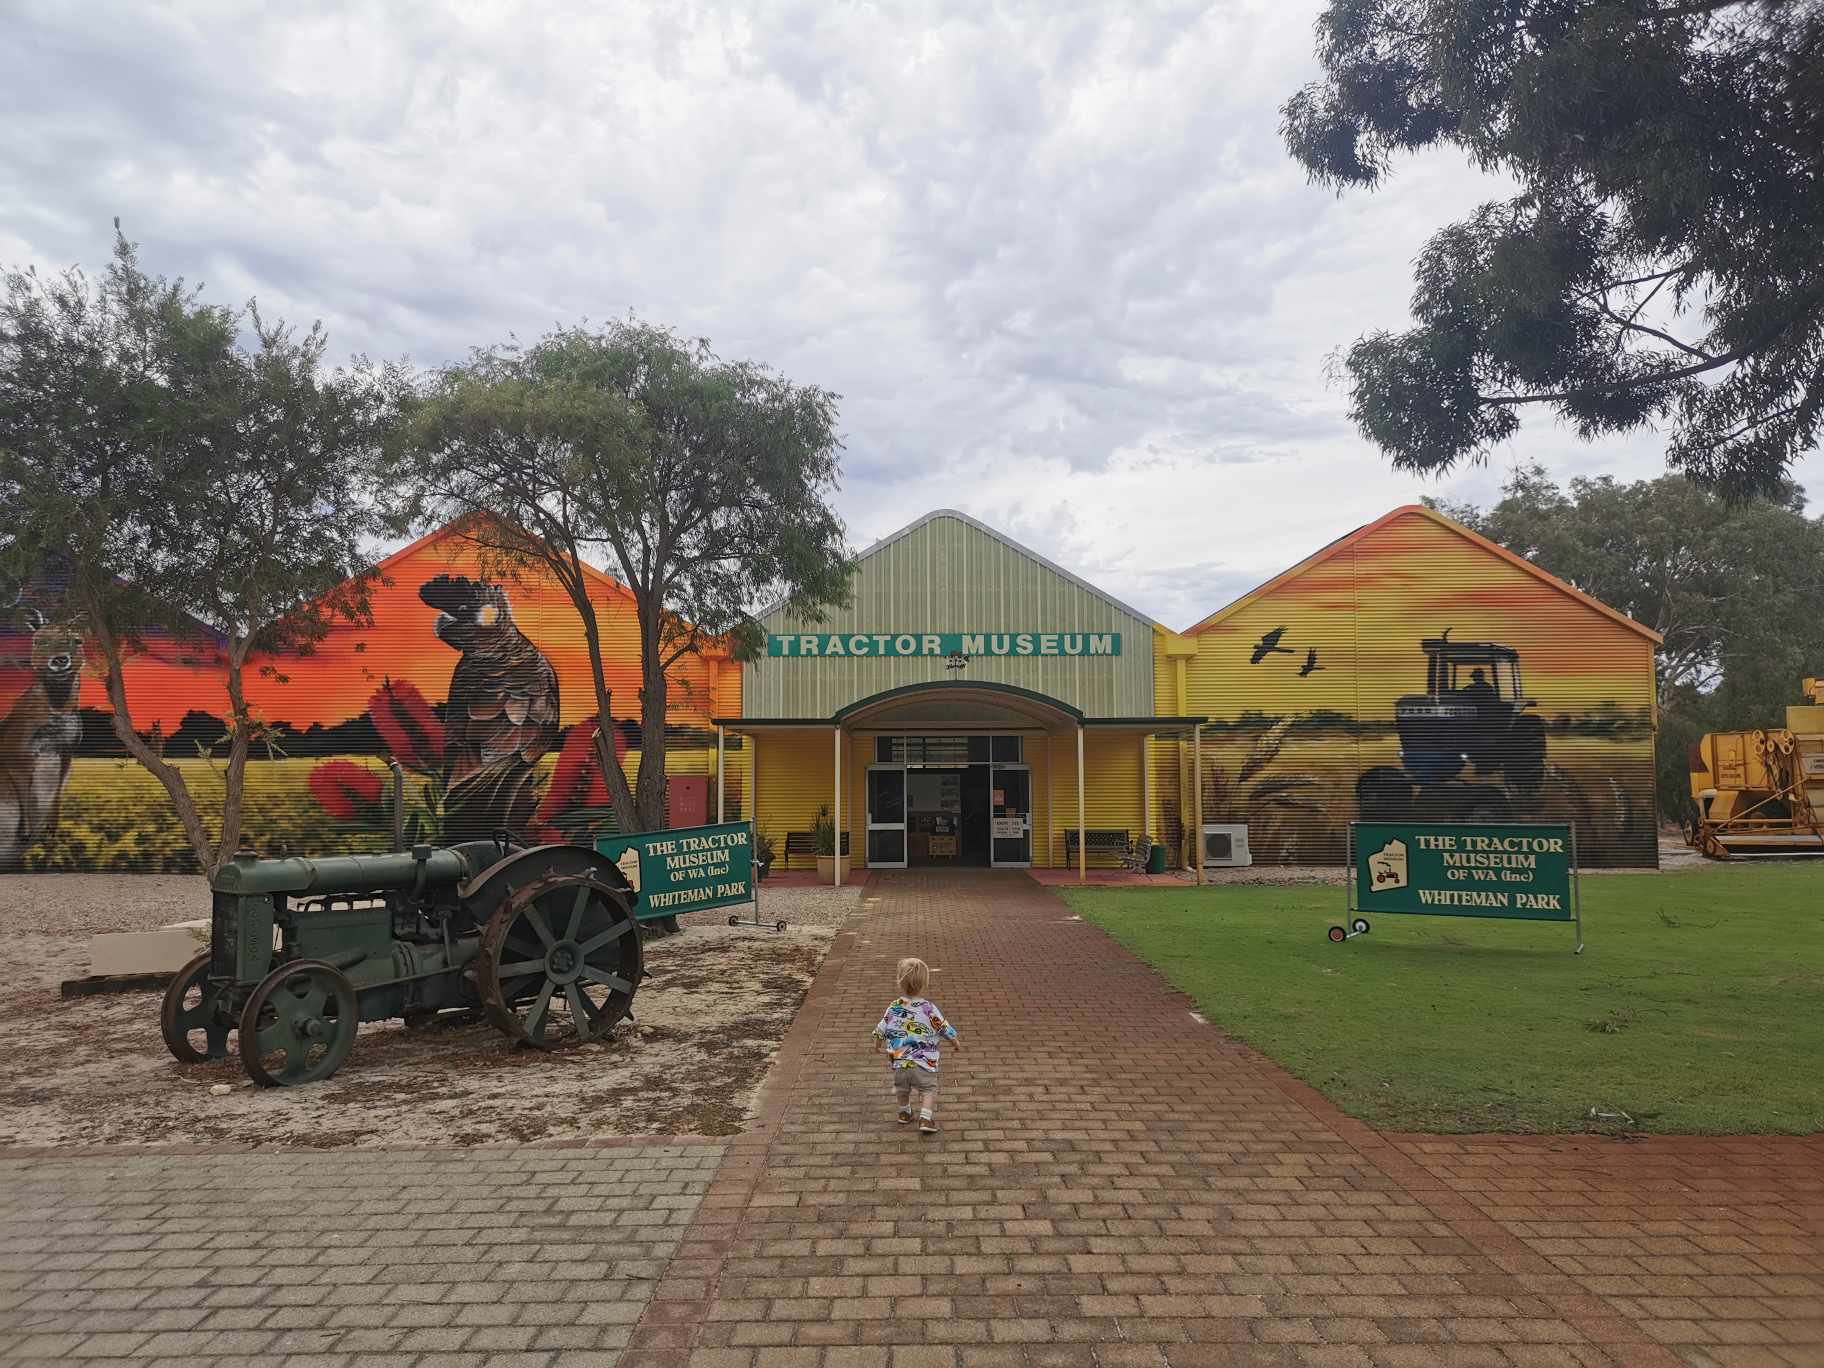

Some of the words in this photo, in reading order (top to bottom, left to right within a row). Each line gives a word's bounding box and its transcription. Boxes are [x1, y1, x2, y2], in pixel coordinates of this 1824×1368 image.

[776, 634, 942, 656] TRACTOR
[962, 634, 1113, 656] MUSEUM
[645, 841, 677, 857] THE
[680, 832, 748, 852] TRACTOR
[1415, 835, 1457, 850] THE
[1461, 836, 1564, 853] TRACTOR
[666, 849, 730, 870] MUSEUM
[1442, 852, 1537, 869] MUSEUM
[670, 870, 686, 882] OF
[687, 868, 706, 879] WA
[707, 864, 729, 876] (Inc)
[1447, 869, 1469, 880] OF
[1471, 869, 1498, 881] WA
[1501, 870, 1534, 882] (Inc)
[649, 886, 714, 909] WHITEMAN
[717, 881, 746, 898] PARK
[1418, 889, 1509, 907] WHITEMAN
[1515, 893, 1562, 910] PARK
